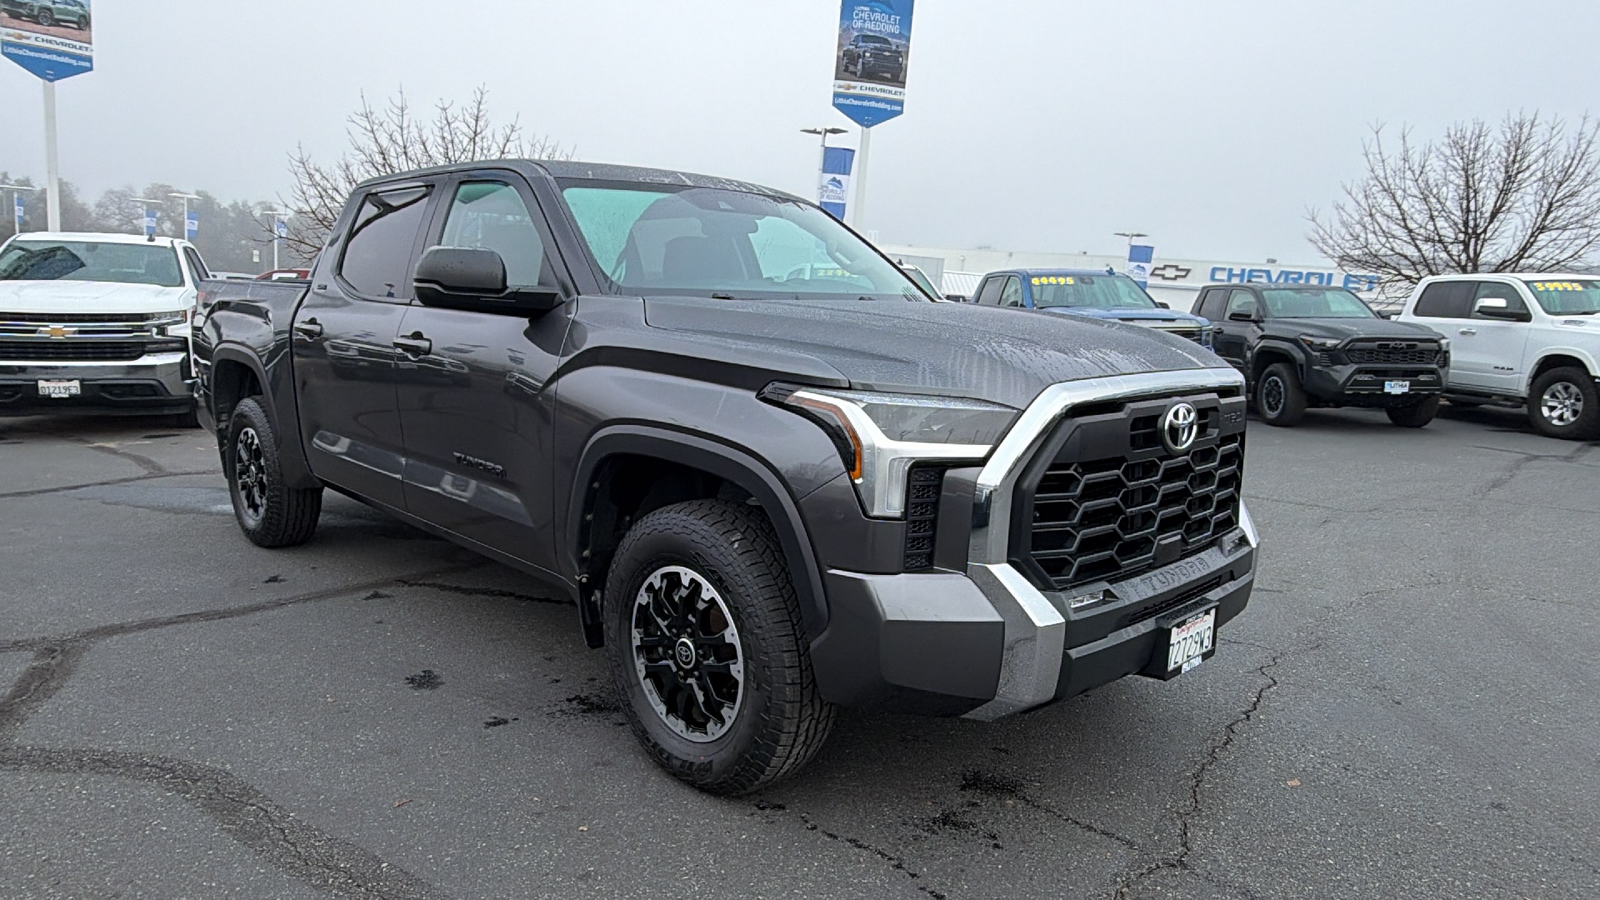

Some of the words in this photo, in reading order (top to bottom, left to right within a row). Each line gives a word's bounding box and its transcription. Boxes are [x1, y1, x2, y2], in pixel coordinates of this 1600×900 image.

[853, 10, 901, 24] CHEVROLET
[852, 19, 864, 29] OF
[864, 20, 900, 34] REDDING
[34, 36, 90, 51] CHEVROLET
[859, 85, 903, 96] CHEVROLET
[1533, 282, 1583, 291] 39995
[453, 451, 508, 479] TUNDRA
[1140, 557, 1211, 591] TUNDRA
